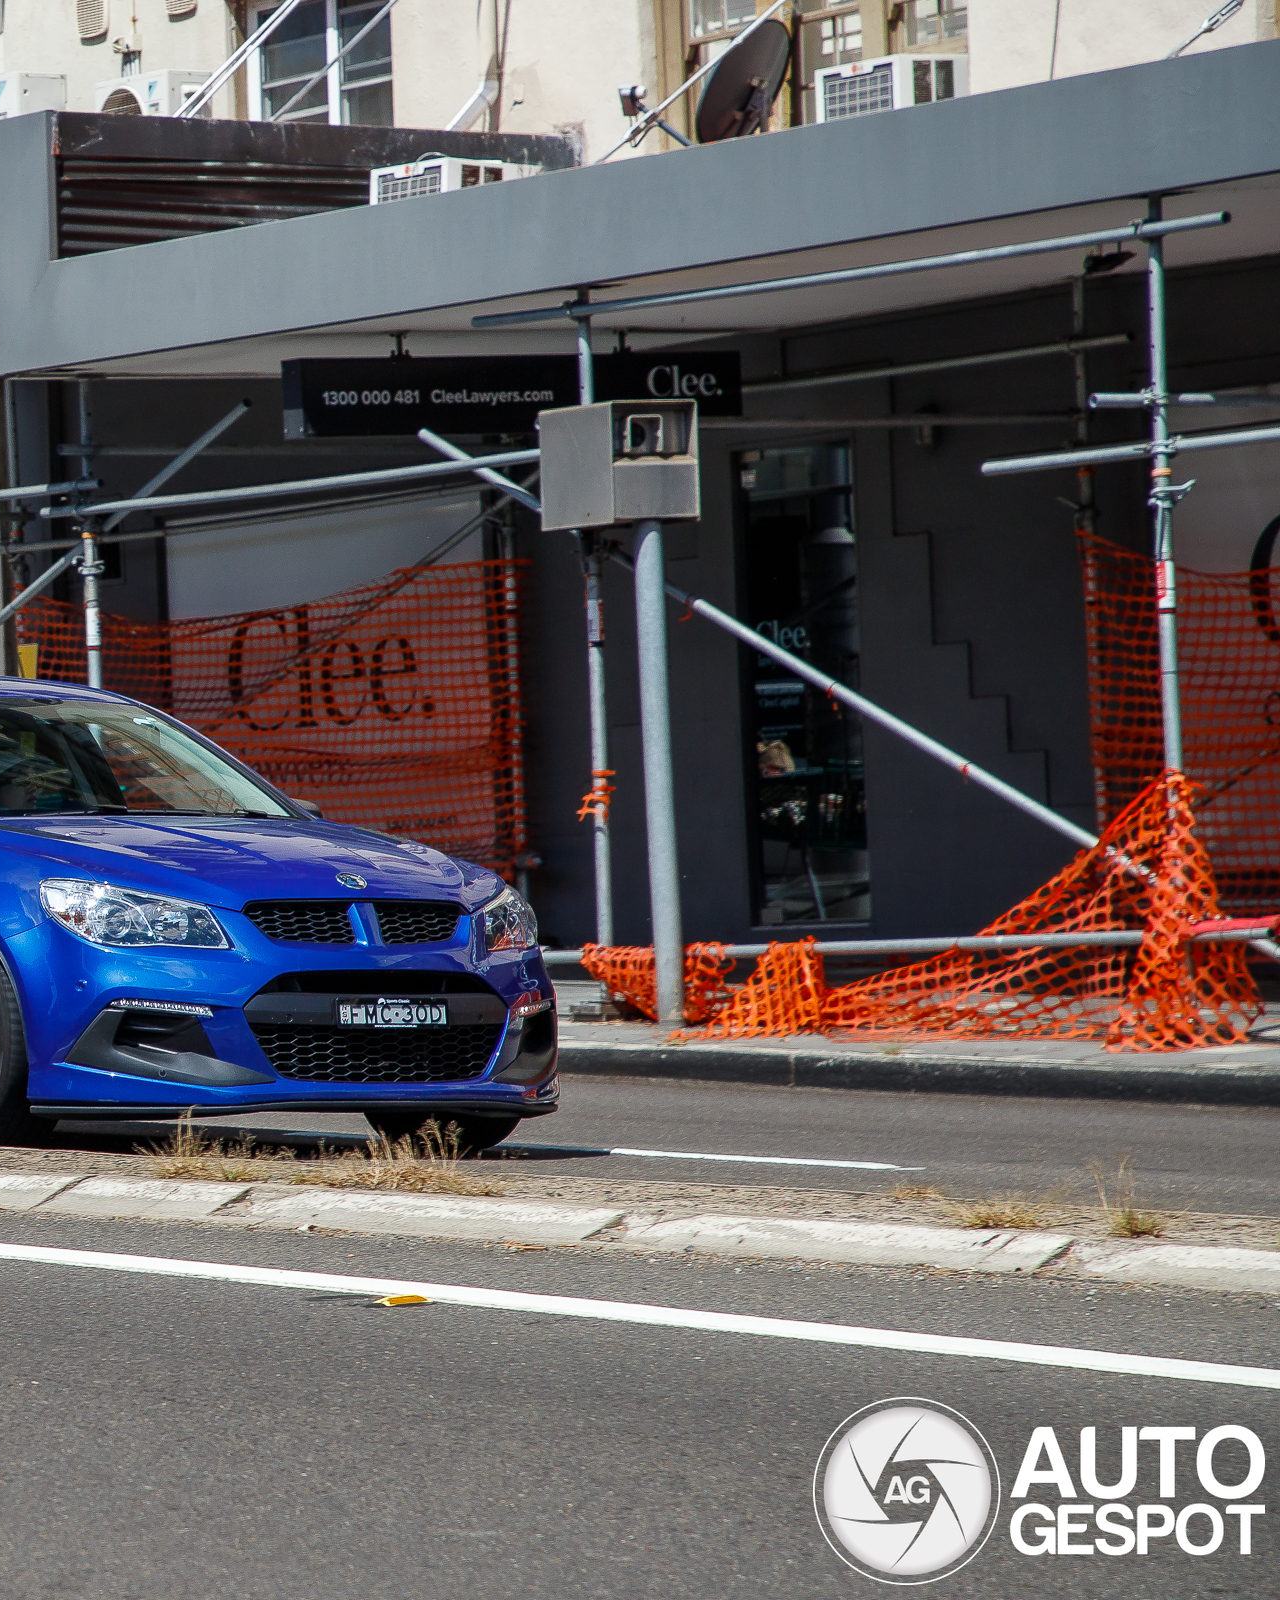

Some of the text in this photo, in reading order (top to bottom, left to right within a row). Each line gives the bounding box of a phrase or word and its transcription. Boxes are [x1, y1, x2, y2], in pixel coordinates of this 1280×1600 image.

[647, 364, 723, 398] Clee.
[322, 387, 553, 407] 1300 000 481 CleeLawyers.com
